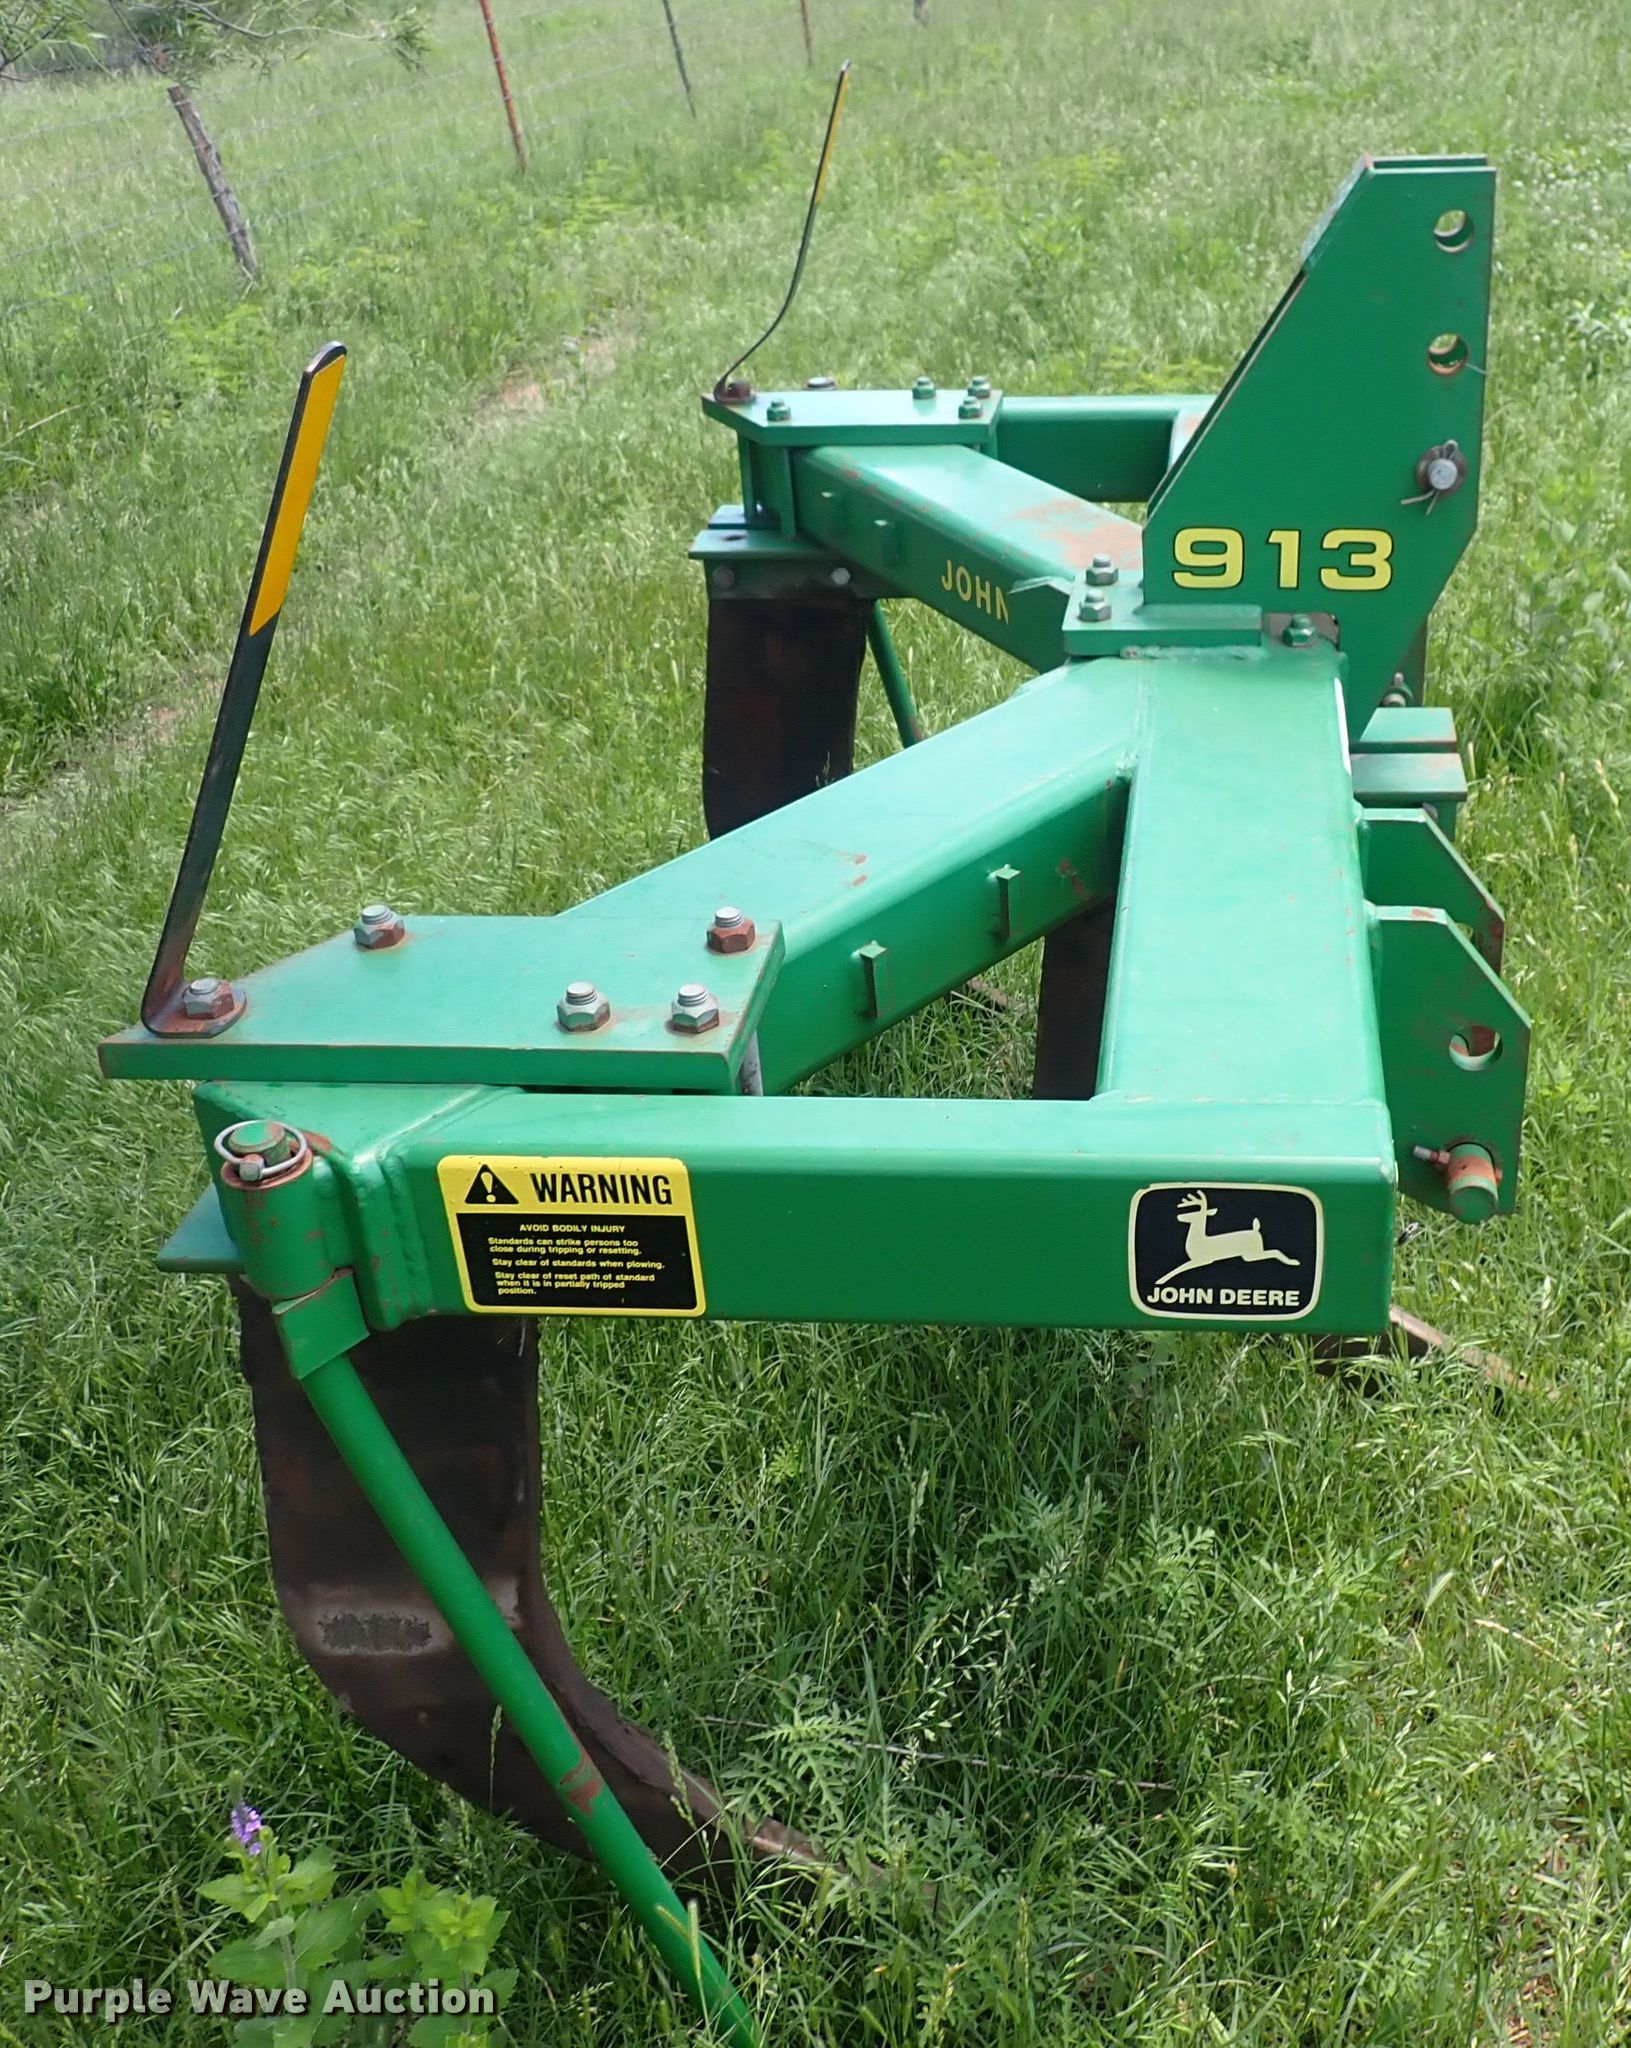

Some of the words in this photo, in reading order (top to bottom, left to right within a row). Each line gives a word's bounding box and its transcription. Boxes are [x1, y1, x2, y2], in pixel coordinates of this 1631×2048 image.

[1172, 526, 1394, 591] 913
[530, 1173, 672, 1205] WARNING
[519, 1224, 549, 1232] AVOID
[552, 1224, 587, 1233] BODILY
[590, 1225, 625, 1233] INJURY
[488, 1237, 534, 1245] Standards
[556, 1238, 581, 1246] strike
[584, 1239, 620, 1247] persons
[623, 1239, 638, 1247] too
[489, 1245, 514, 1253] close
[516, 1245, 546, 1254] during
[548, 1246, 584, 1255] tripping
[599, 1247, 642, 1256] resetting.
[492, 1258, 512, 1267] Stay
[515, 1258, 537, 1266] clear
[552, 1259, 596, 1267] standards
[599, 1260, 624, 1268] when
[626, 1260, 666, 1270] plowing.
[494, 1271, 515, 1280] Stay
[517, 1271, 540, 1279] clear
[542, 1272, 552, 1280] of
[554, 1272, 578, 1280] reset
[580, 1273, 600, 1281] path
[602, 1273, 612, 1281] of
[615, 1274, 655, 1282] standard
[554, 1280, 591, 1290] partially
[592, 1281, 625, 1290] tripped
[498, 1287, 537, 1295] position.
[1147, 1287, 1213, 1305] JOHN
[1220, 1288, 1300, 1307] DEERE
